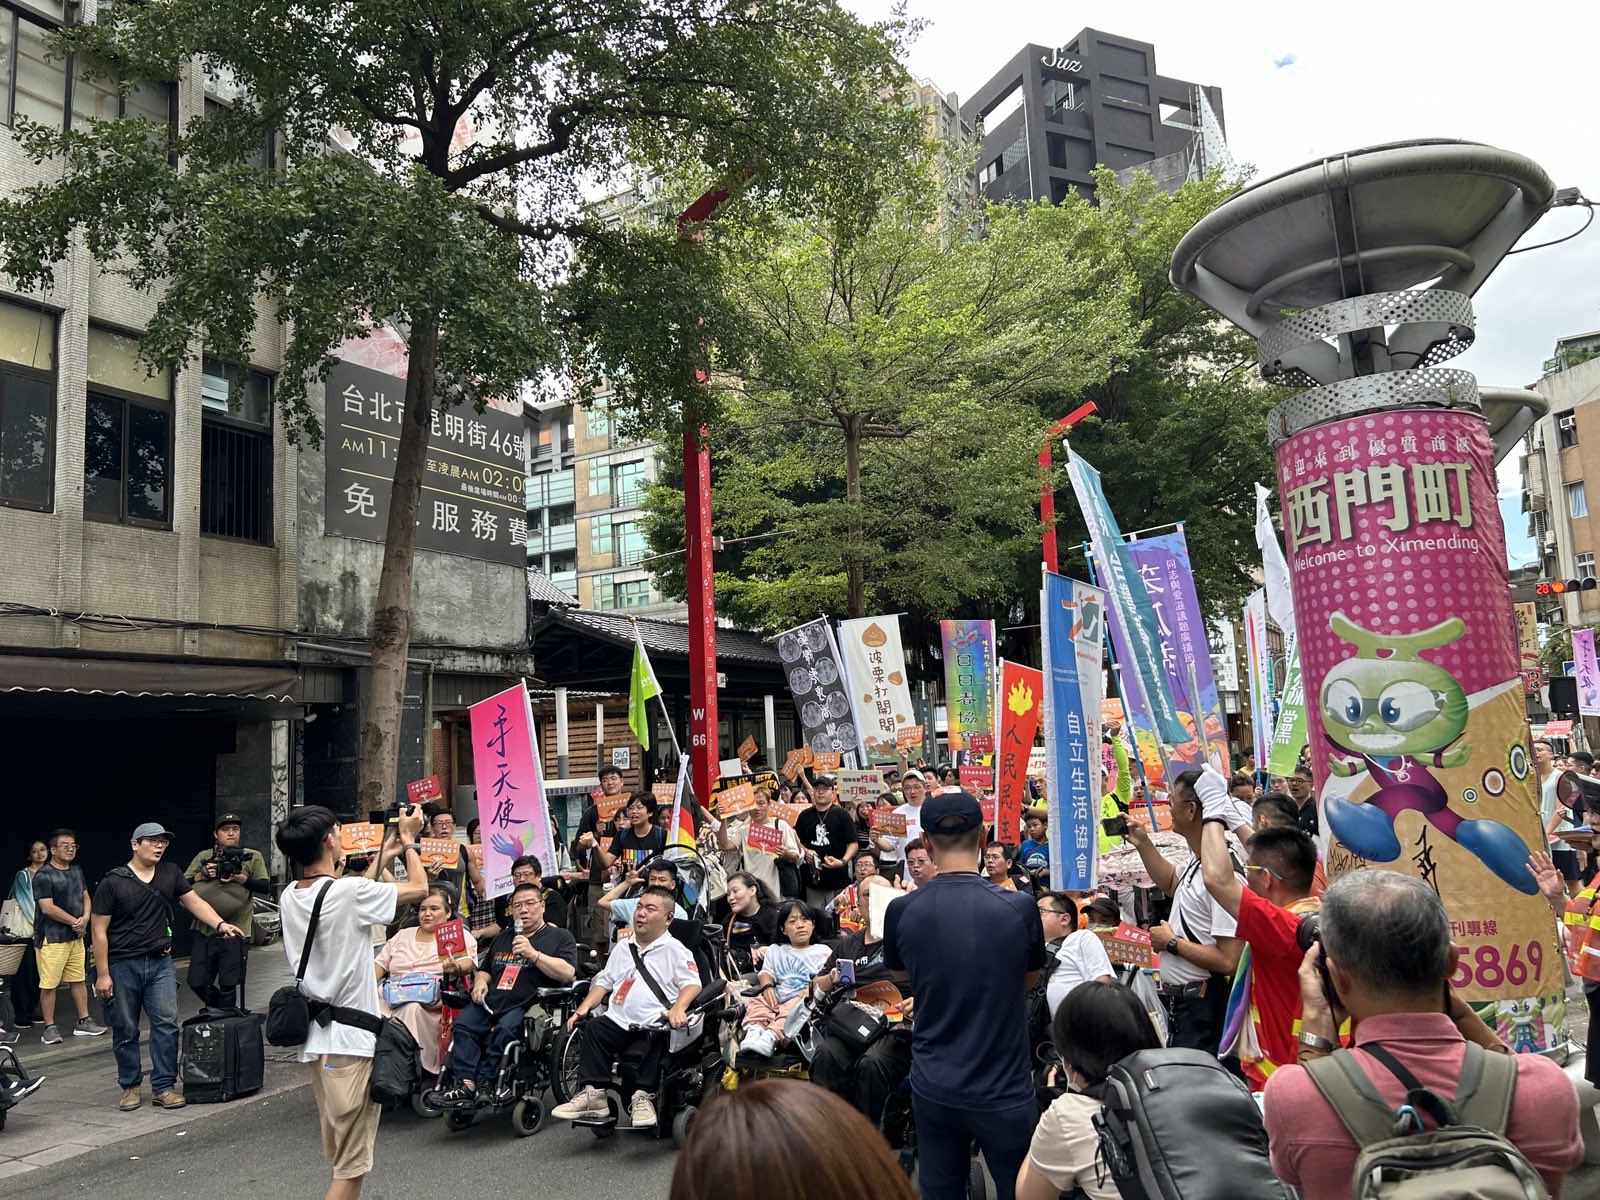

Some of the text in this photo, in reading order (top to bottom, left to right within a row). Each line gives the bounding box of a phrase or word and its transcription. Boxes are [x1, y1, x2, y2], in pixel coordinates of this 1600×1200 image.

[343, 482, 527, 547] 免服務費
[1286, 461, 1473, 554] 西門町
[1294, 533, 1479, 572] Welcome to Ximending
[1536, 583, 1549, 595] 28
[692, 708, 705, 720] W
[692, 734, 707, 746] 66
[487, 703, 529, 829] 手天使
[1066, 711, 1089, 879] 自立生活協會
